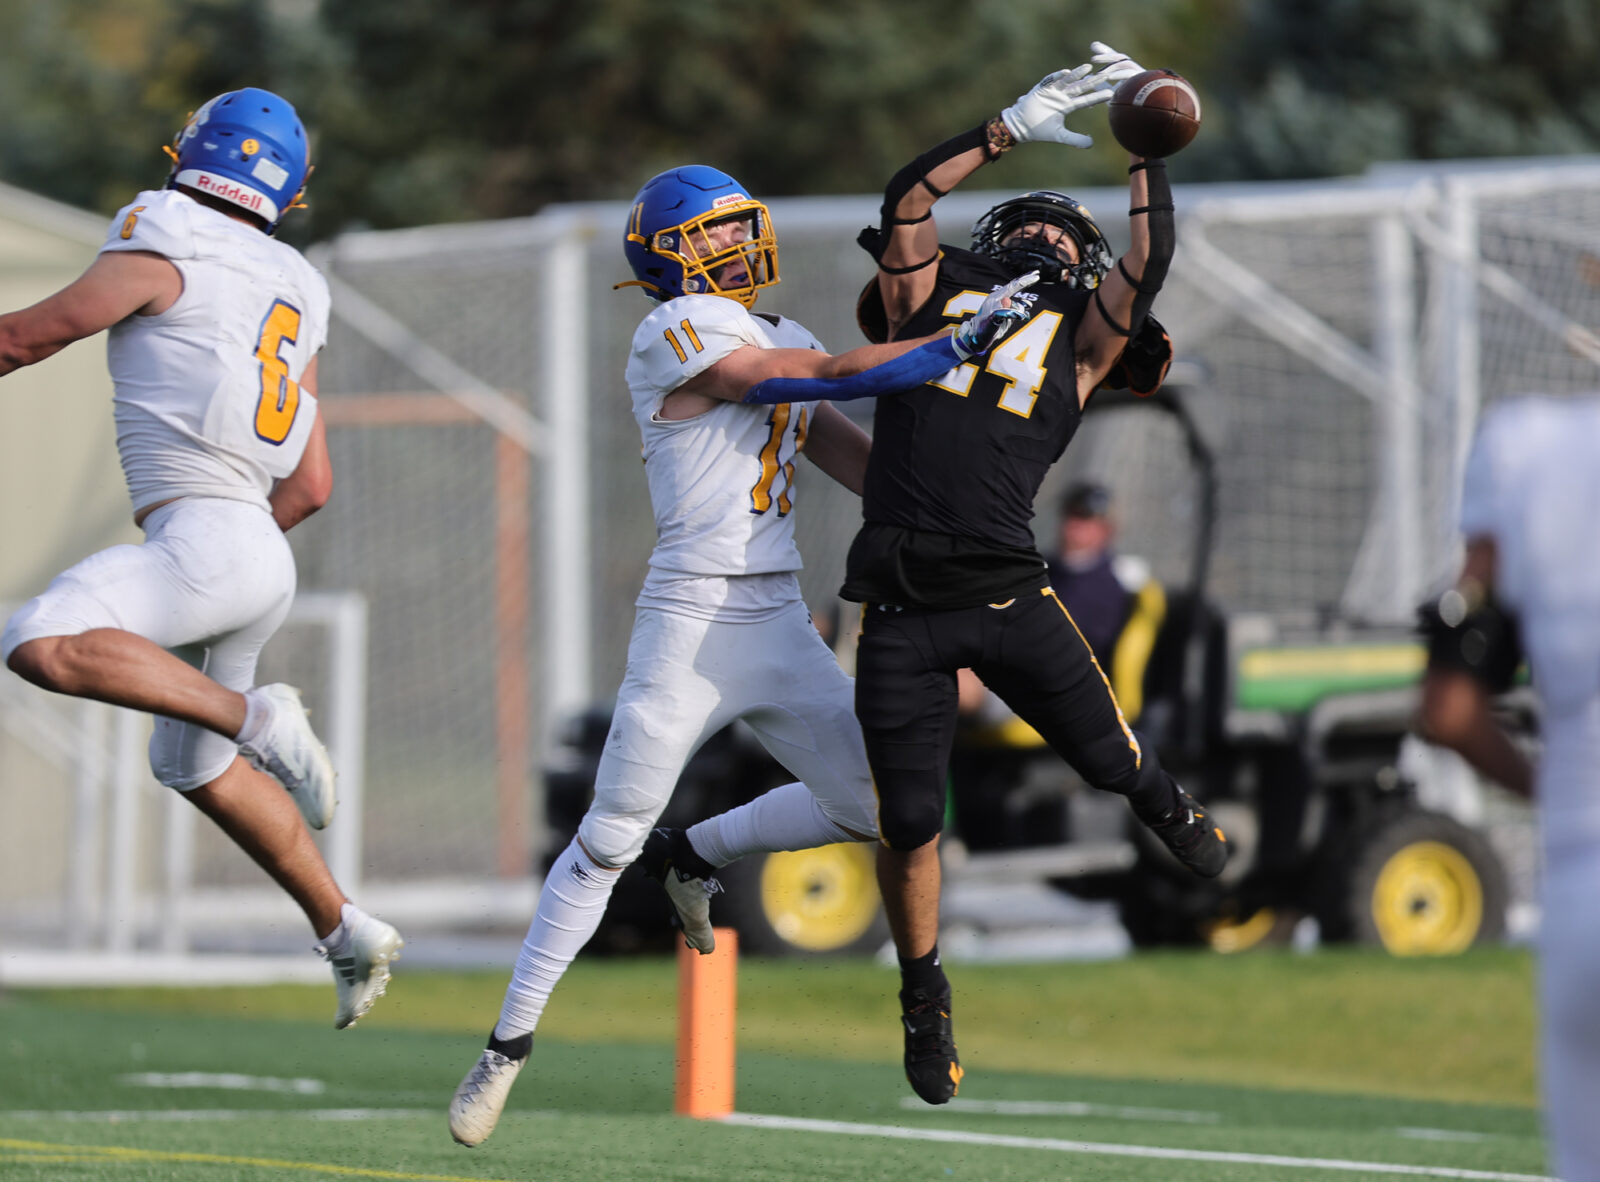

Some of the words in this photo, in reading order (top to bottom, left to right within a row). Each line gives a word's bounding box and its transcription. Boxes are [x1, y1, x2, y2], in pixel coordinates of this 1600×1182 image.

[197, 175, 264, 211] Riddell
[120, 206, 146, 239] 6
[663, 318, 705, 365] 11
[252, 297, 302, 446] 6
